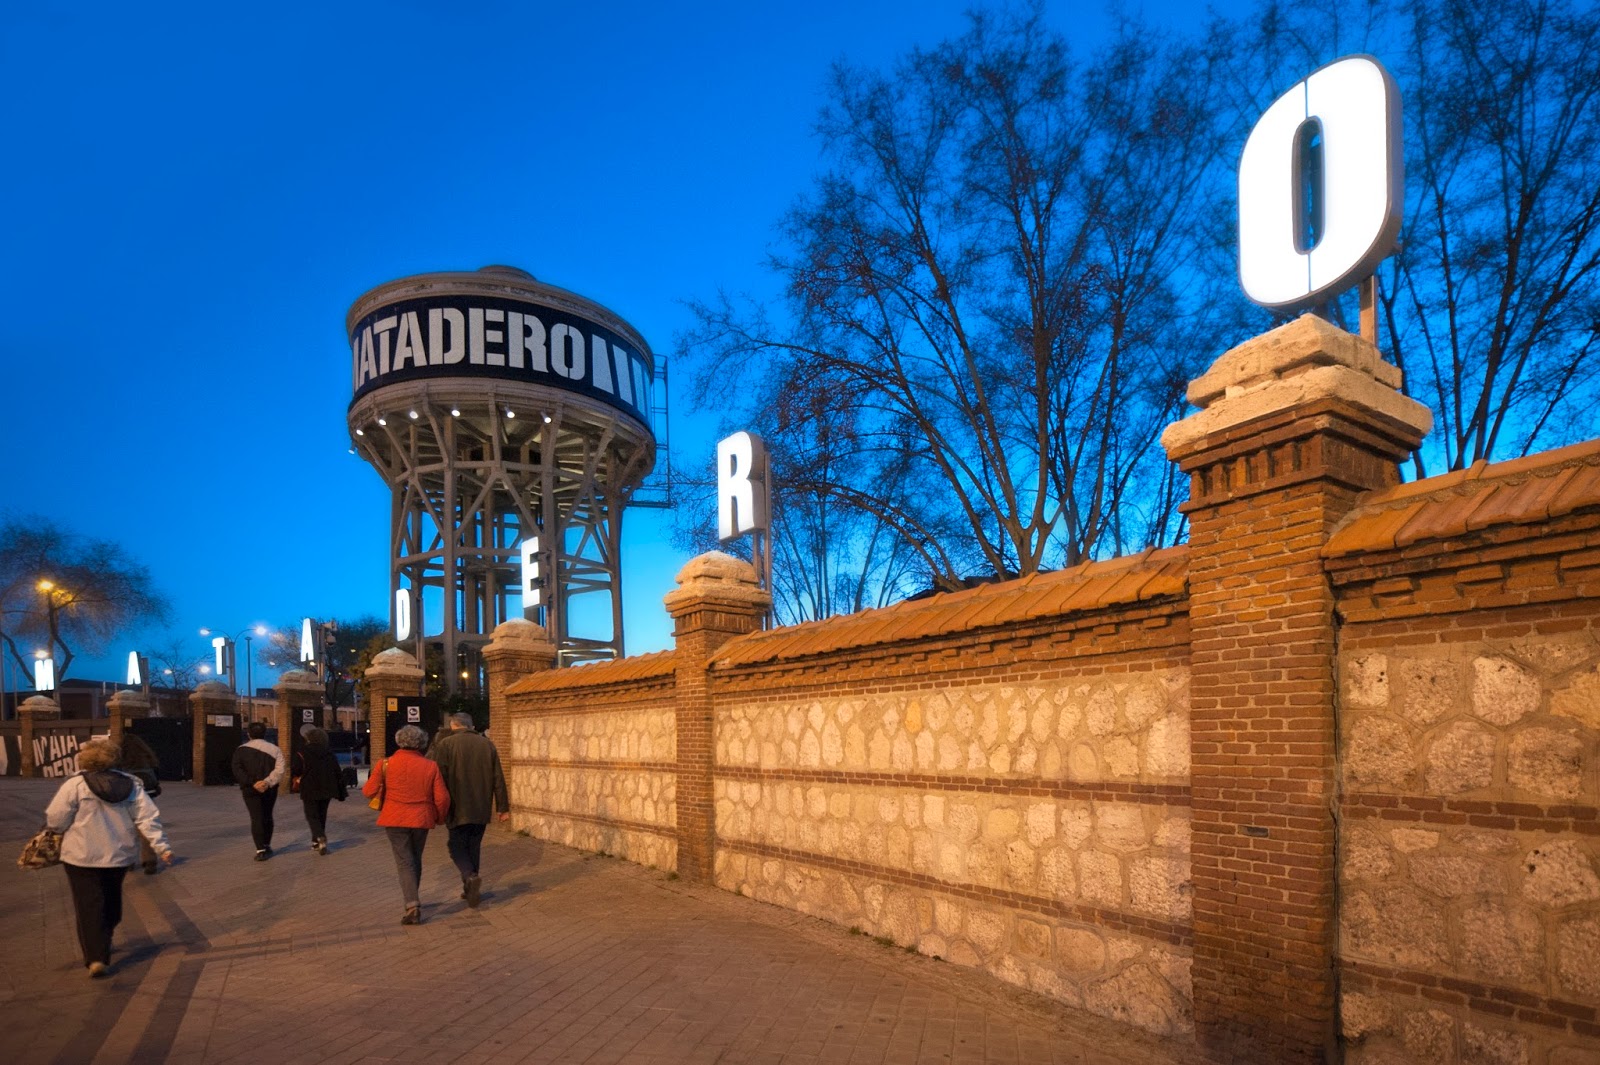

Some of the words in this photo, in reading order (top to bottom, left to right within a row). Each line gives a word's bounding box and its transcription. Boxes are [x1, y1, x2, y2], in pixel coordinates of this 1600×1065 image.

[35, 658, 54, 691] M
[127, 650, 141, 685] A
[212, 636, 226, 675] T
[300, 617, 314, 662] A
[396, 588, 411, 641] D
[521, 536, 540, 608] E
[717, 430, 755, 540] R
[1237, 55, 1389, 305] O
